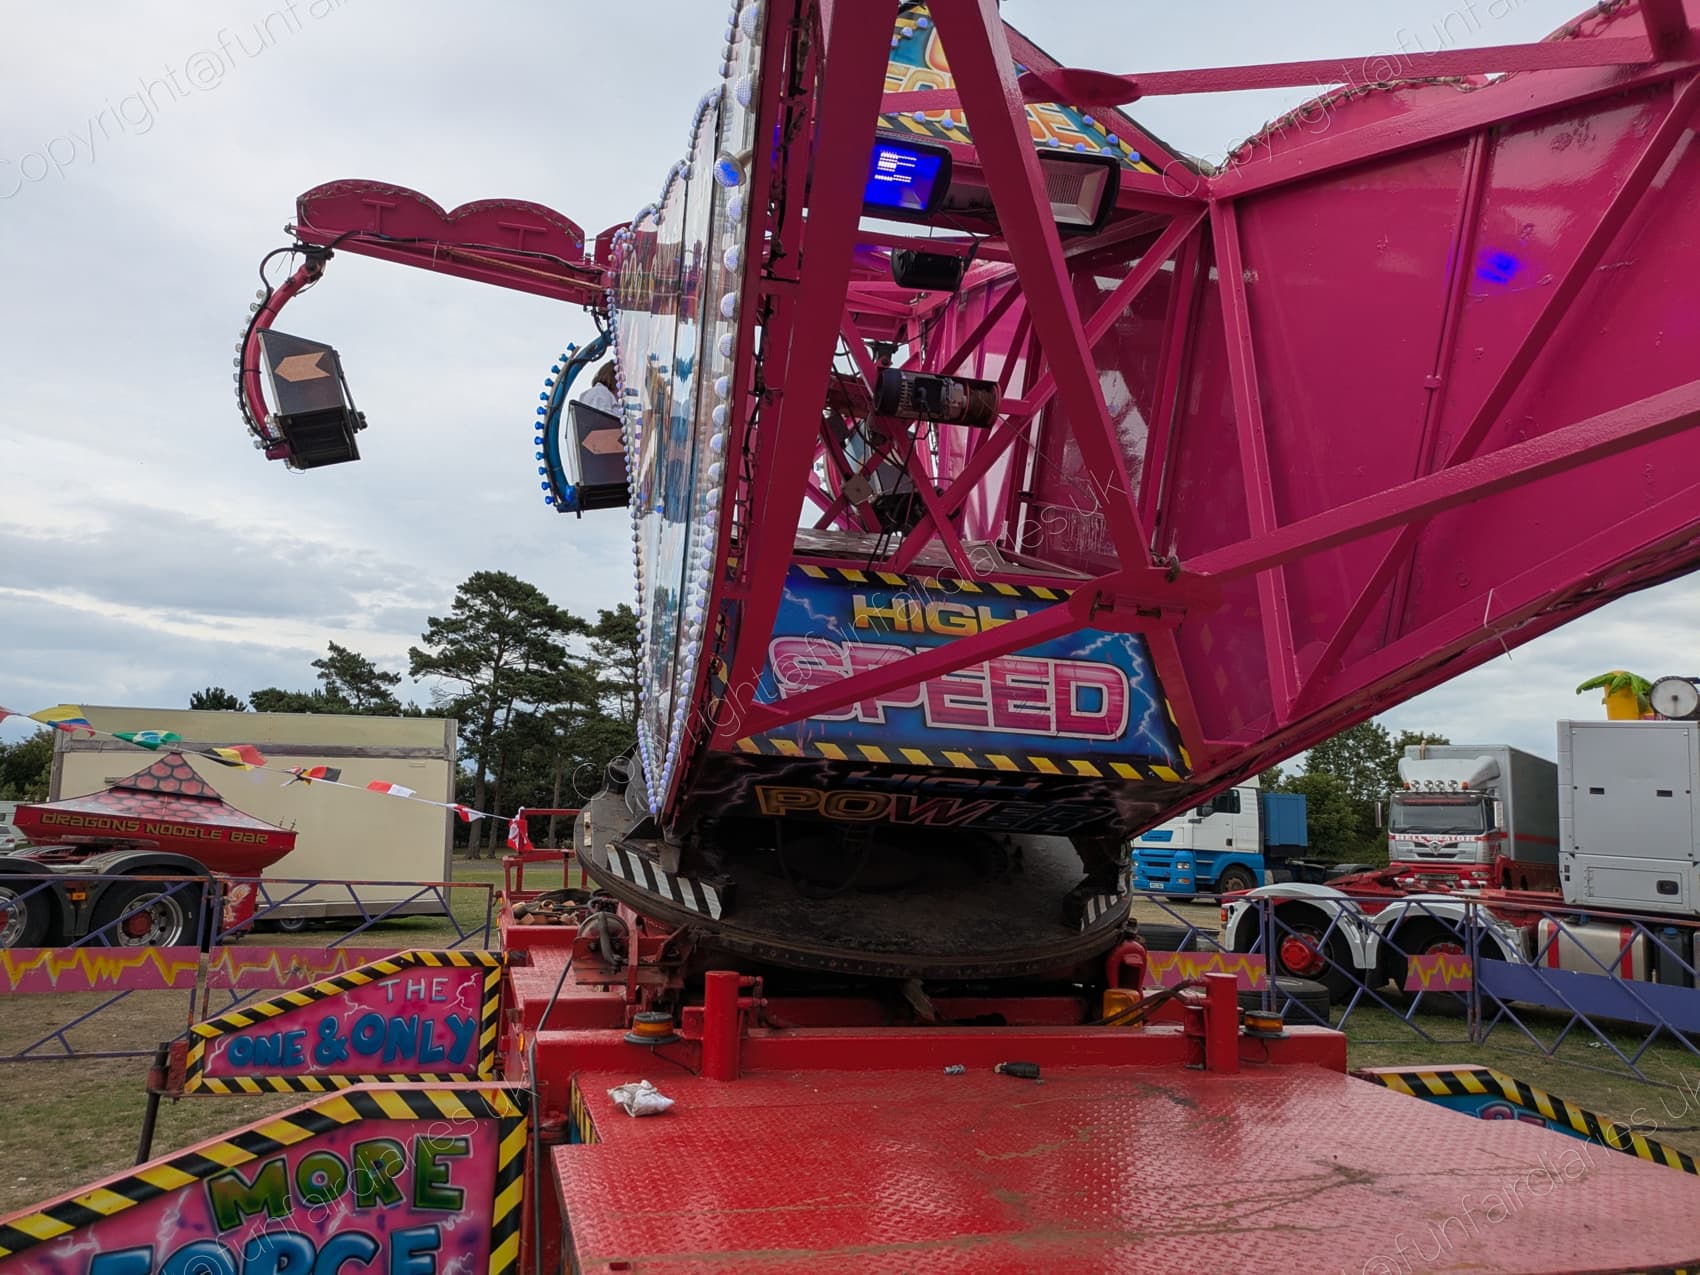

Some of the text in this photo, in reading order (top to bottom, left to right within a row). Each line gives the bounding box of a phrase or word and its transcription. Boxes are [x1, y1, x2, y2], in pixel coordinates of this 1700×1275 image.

[852, 594, 1029, 638] HIGH
[768, 635, 1131, 742] SPEED
[40, 813, 269, 844] DRAGONS NOODLE BAR
[754, 785, 1116, 832] POWER
[378, 977, 449, 1002] THE
[227, 1013, 477, 1067] ONE & ONLY
[204, 1133, 473, 1233] MORE
